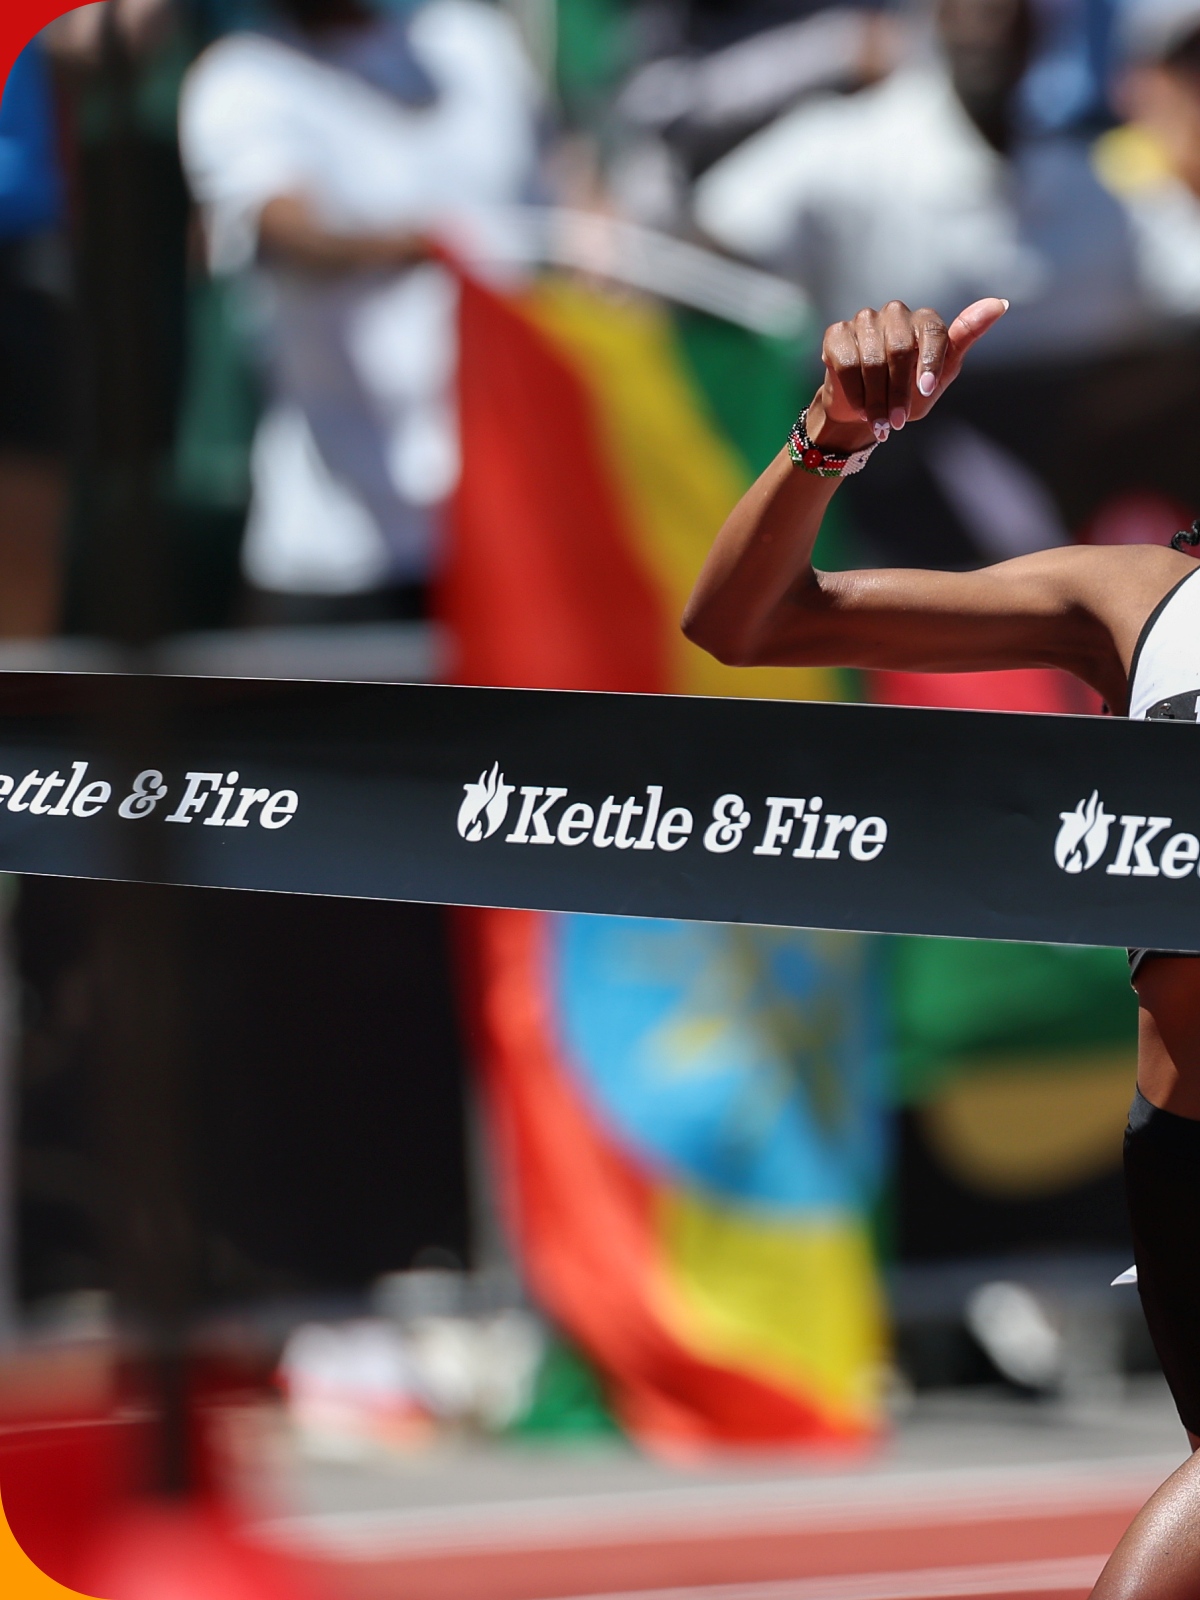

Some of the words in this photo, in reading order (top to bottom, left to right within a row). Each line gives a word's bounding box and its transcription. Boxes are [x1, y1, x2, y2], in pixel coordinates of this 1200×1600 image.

[118, 769, 168, 819] &
[165, 771, 299, 830] Fire
[506, 785, 693, 853] Kettle
[703, 793, 751, 853] &
[753, 796, 888, 861] Fire
